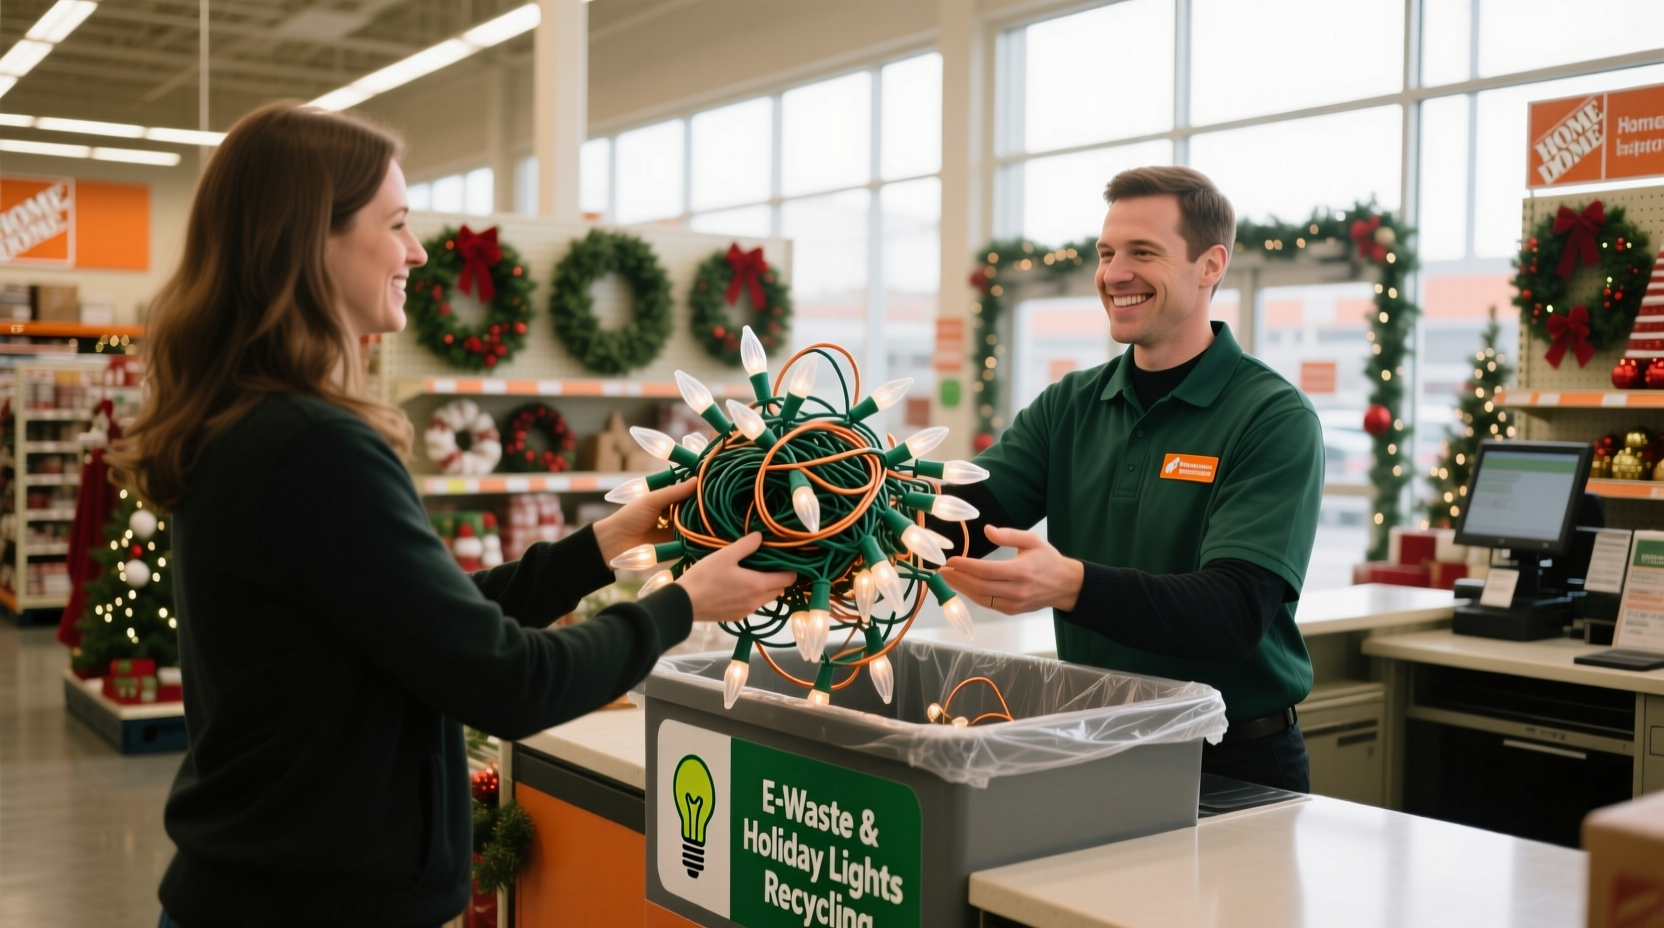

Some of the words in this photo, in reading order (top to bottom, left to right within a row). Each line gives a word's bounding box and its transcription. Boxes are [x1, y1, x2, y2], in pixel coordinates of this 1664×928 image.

[1534, 98, 1604, 164] HOME
[1537, 124, 1604, 186] DOME
[1617, 115, 1664, 135] Home
[762, 778, 854, 839] E-Waste
[858, 808, 880, 848] &
[743, 817, 825, 884] Holiday
[829, 845, 904, 905] Lights
